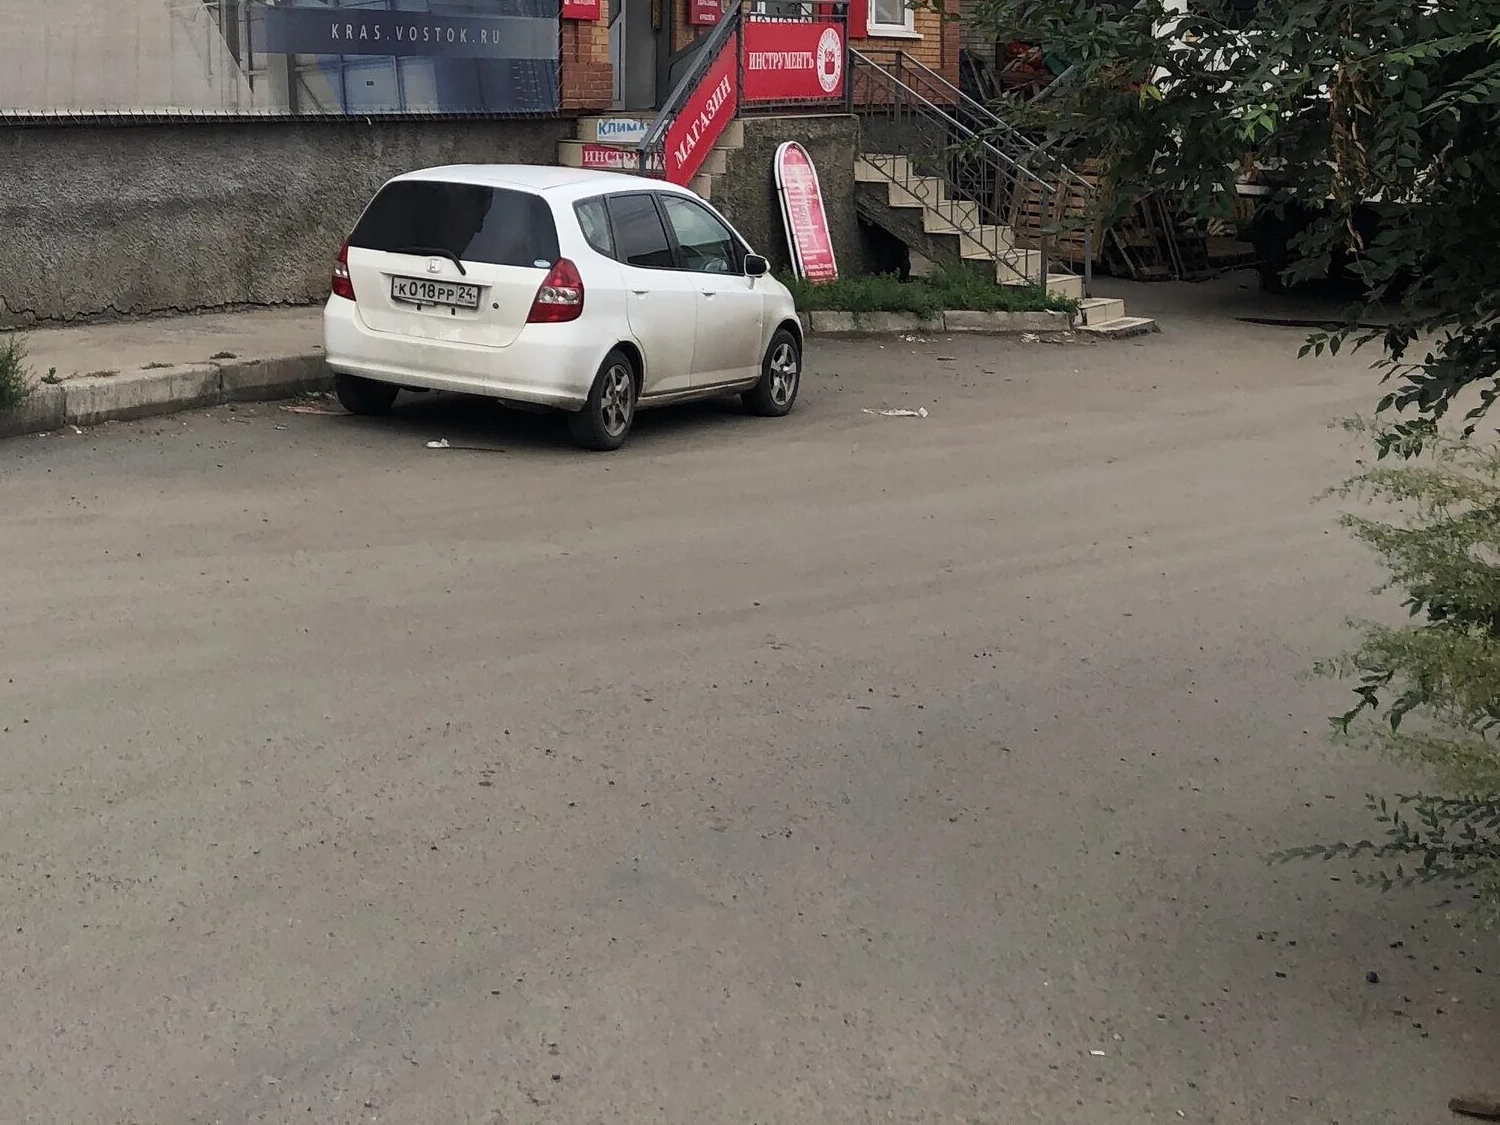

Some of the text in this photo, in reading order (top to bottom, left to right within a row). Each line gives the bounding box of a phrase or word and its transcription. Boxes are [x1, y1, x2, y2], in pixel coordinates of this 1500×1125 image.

[331, 23, 502, 45] KRAS.VOSTOK.RU
[748, 51, 815, 70] ИНСТРУМЕНТЪ
[673, 74, 732, 169] МАГАЗИН
[398, 281, 473, 301] К018РР 24
